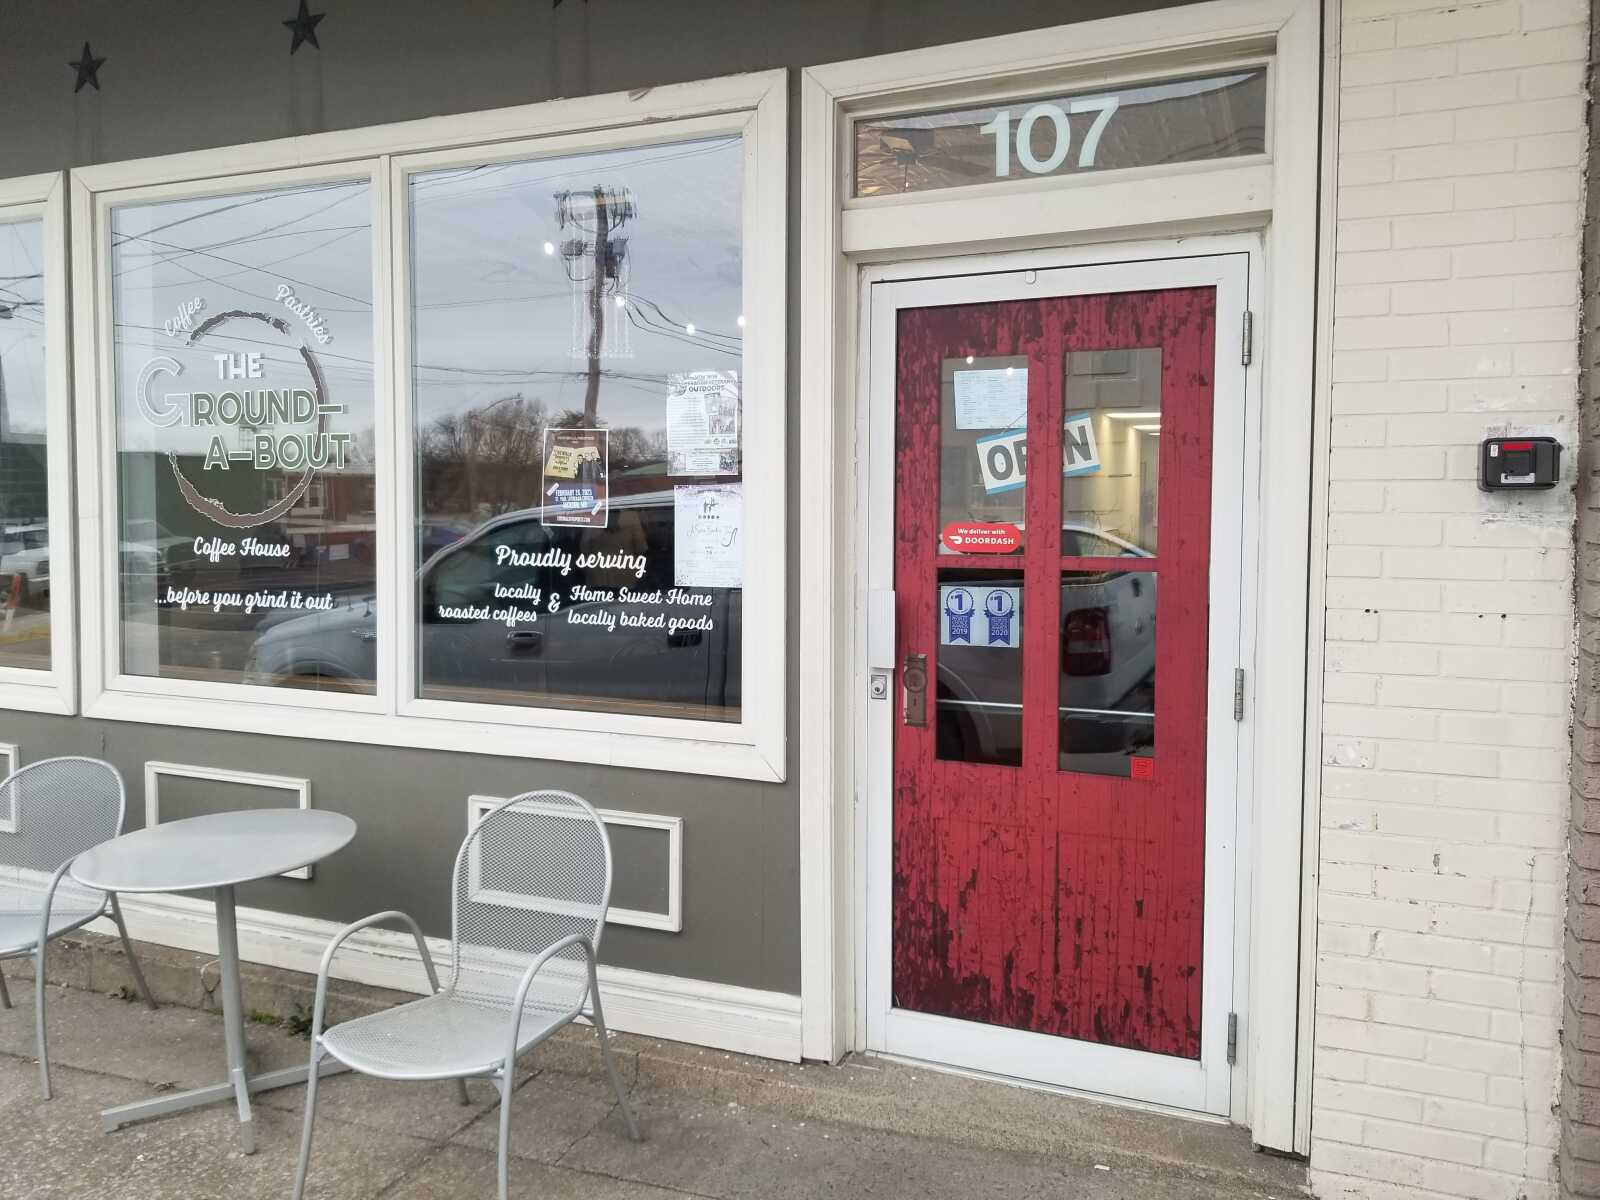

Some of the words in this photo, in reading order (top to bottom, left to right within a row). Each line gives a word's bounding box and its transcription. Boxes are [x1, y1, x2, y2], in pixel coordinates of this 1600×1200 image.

[980, 96, 1119, 178] 107
[164, 296, 206, 338] Coffee
[276, 284, 335, 345] Pastries
[214, 352, 264, 380] THE
[203, 433, 351, 470] A-BOUT
[986, 425, 1092, 481] OPN
[957, 527, 968, 535] We
[965, 537, 1014, 545] DOORDASH
[193, 536, 236, 562] Coffee
[240, 537, 291, 558] House
[495, 545, 572, 576] Proudly
[575, 549, 647, 578] serving
[212, 593, 243, 615] you
[244, 590, 289, 615] grind
[290, 591, 304, 610] it
[305, 593, 334, 610] out
[494, 583, 541, 605] locally
[548, 592, 560, 613] &
[570, 585, 614, 603] Home
[618, 587, 662, 605] Sweet
[666, 588, 712, 606] Home
[438, 604, 491, 621] roasted
[492, 605, 537, 627] coffees
[568, 609, 615, 632] locally
[619, 610, 666, 627] baked
[668, 612, 714, 635] goods
[951, 627, 968, 635] 2019
